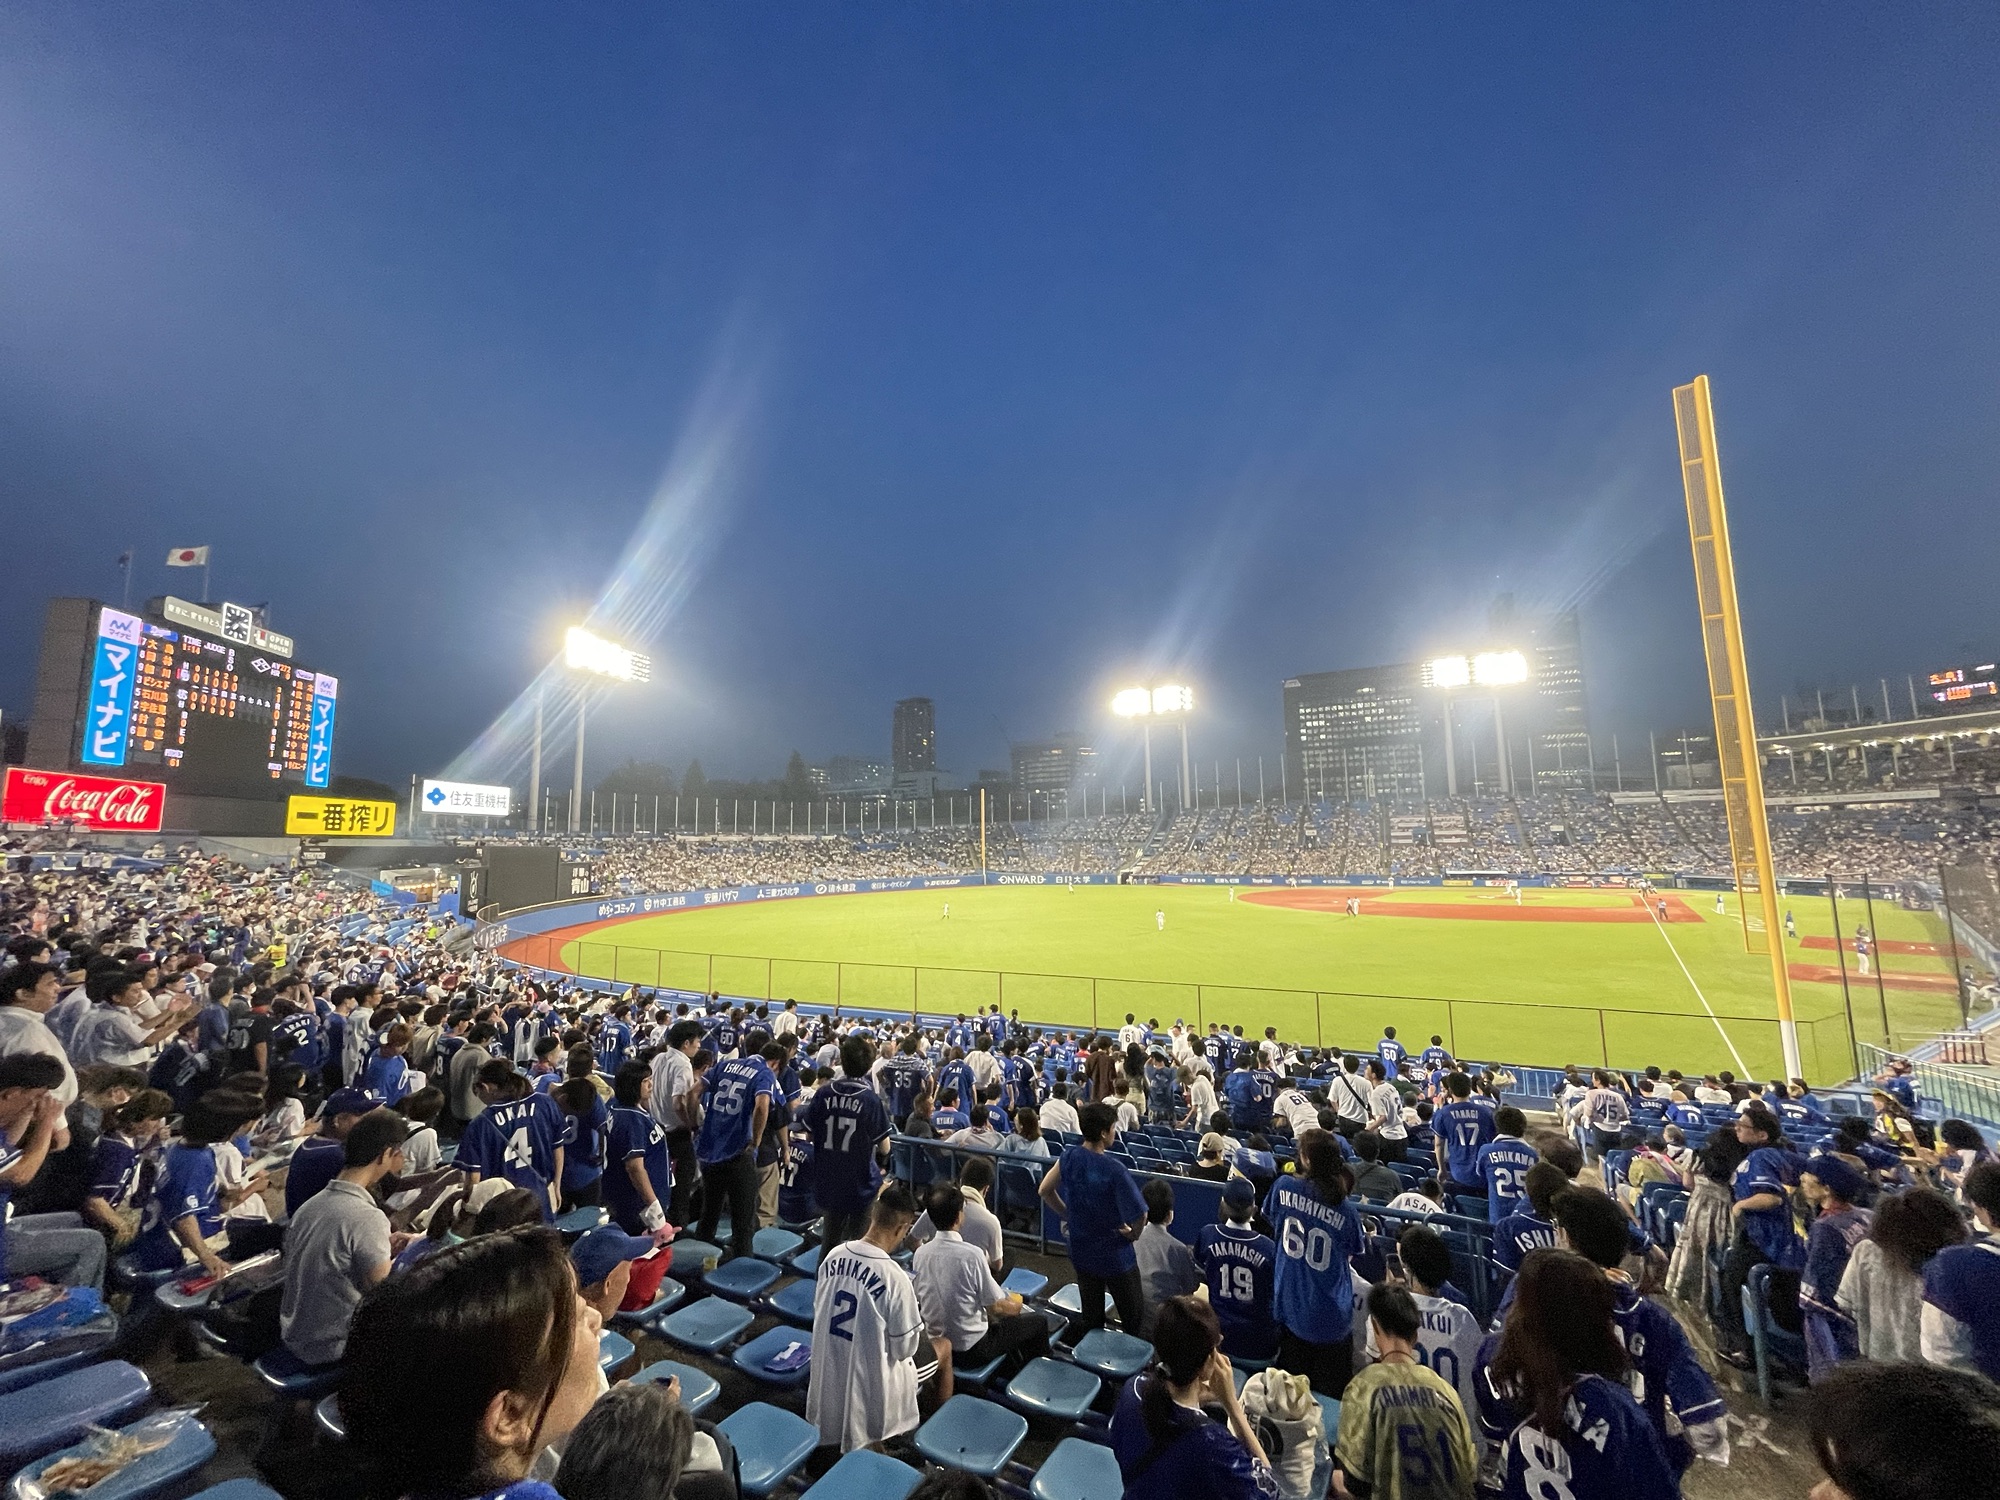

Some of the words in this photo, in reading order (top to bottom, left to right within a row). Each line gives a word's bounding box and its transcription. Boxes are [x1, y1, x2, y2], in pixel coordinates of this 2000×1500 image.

[182, 635, 202, 647] TIME
[203, 642, 226, 654] JUDGE
[269, 635, 290, 646] OPEN
[269, 644, 289, 654] HOUSE
[94, 643, 131, 758] マイナビ
[311, 699, 332, 783] マイナビ
[23, 773, 49, 787] Enjoy
[44, 779, 155, 824] Coca-Cola
[450, 790, 507, 809] 住友重機械
[297, 803, 390, 832] 一番搾り
[571, 877, 590, 895] 青山
[1000, 875, 1045, 884] ONWARD
[295, 1029, 309, 1045] 2
[1383, 1048, 1396, 1061] 60
[712, 1079, 747, 1116] 25
[824, 1096, 863, 1114] YANAGI
[495, 1103, 535, 1126] UKAI
[1450, 1110, 1478, 1119] YANAGI
[824, 1115, 857, 1152] 17
[1456, 1122, 1480, 1146] 17
[504, 1126, 533, 1169] 4
[1280, 1189, 1346, 1231] OKABAYASHI
[1208, 1242, 1266, 1268] TAKAHASHI
[1282, 1216, 1332, 1272] 60
[825, 1259, 887, 1302] ISHIKAWA
[1220, 1263, 1254, 1301] 19
[829, 1289, 858, 1341] 2
